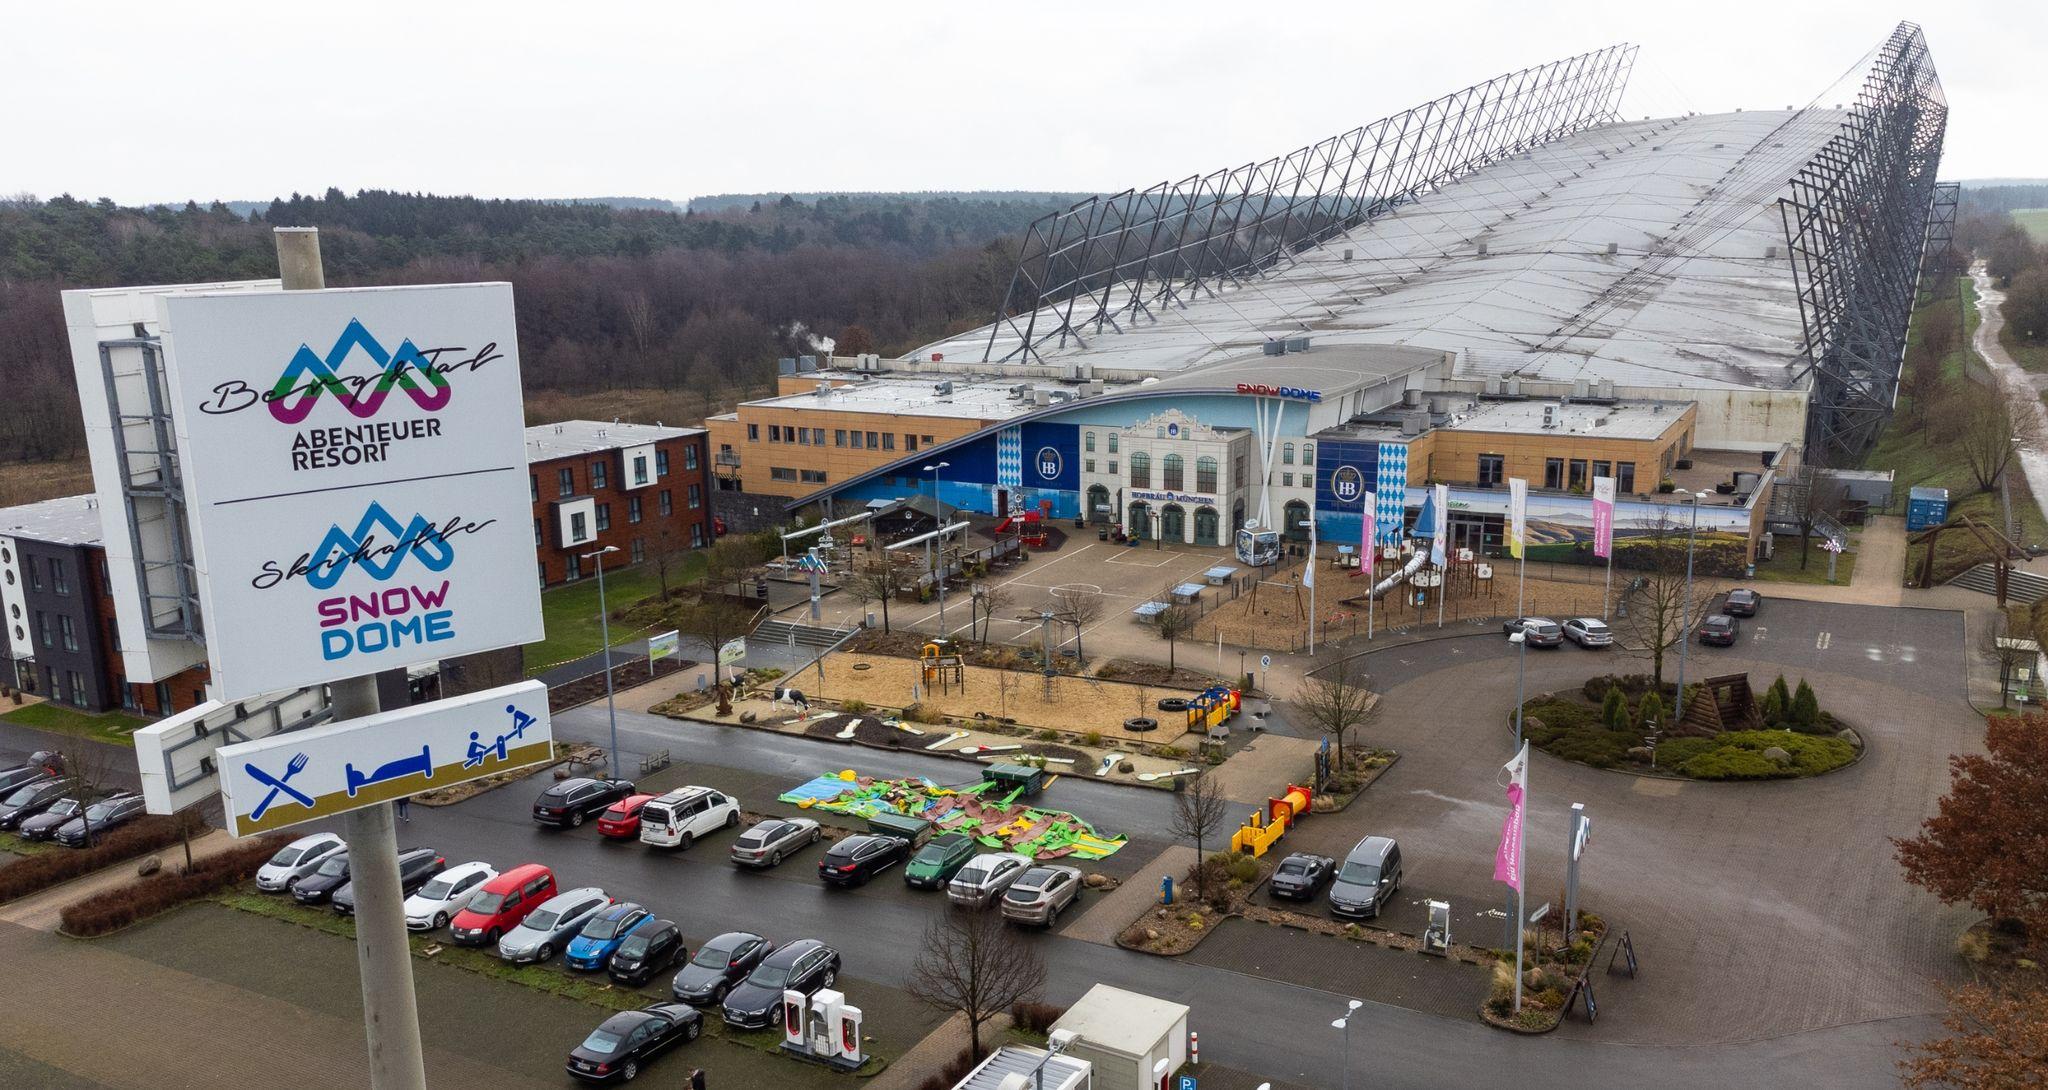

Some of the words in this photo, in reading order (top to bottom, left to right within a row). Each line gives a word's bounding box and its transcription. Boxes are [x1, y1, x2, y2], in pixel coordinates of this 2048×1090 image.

[200, 373, 385, 414] Berg
[417, 342, 504, 377] Tal
[1236, 383, 1322, 401] SNOWDOME
[292, 418, 442, 451] ABENTEUER
[292, 442, 391, 471] RESORT
[1042, 461, 1056, 475] HB
[1339, 481, 1355, 496] HB
[252, 516, 497, 589] Skihalle
[318, 580, 450, 628] SNOW
[321, 609, 456, 661] DOME
